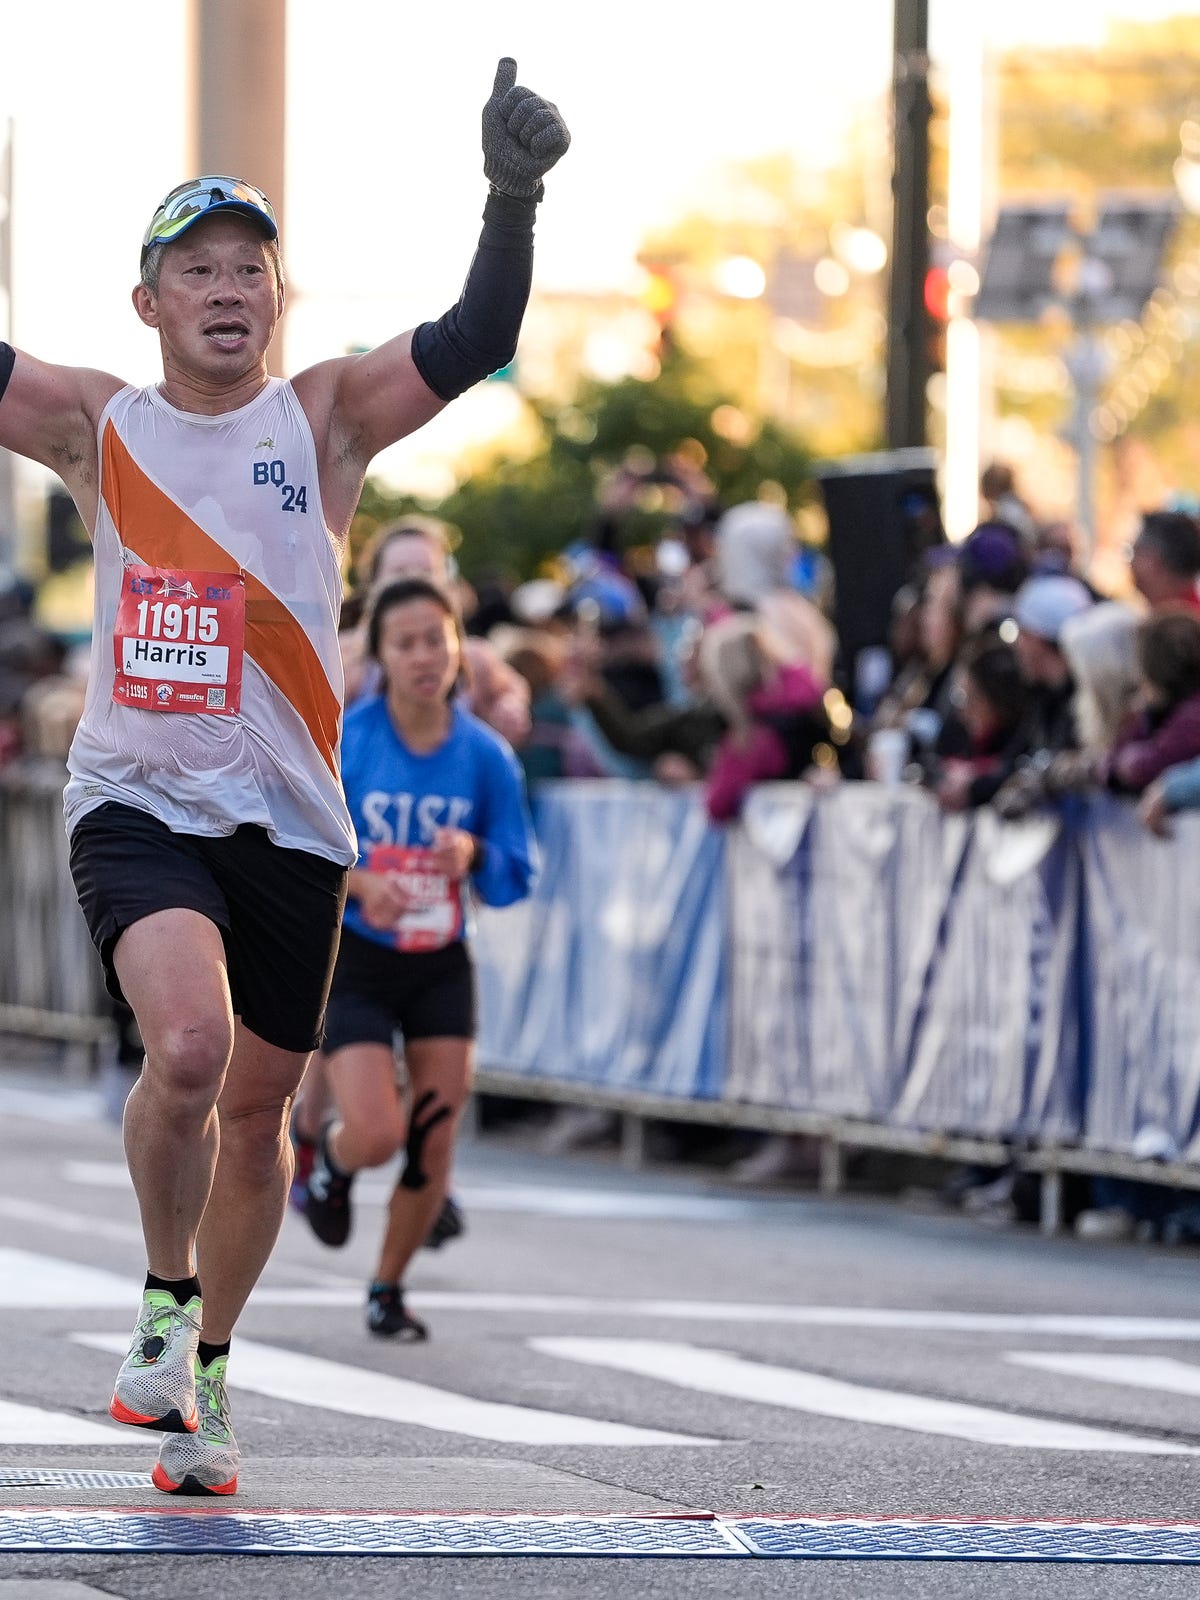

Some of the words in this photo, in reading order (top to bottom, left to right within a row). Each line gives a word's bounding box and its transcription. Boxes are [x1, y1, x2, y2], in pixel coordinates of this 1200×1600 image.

[253, 460, 286, 488] BQ
[281, 485, 307, 514] 24
[137, 600, 219, 643] 11915
[125, 660, 133, 670] A
[135, 640, 207, 667] Harris
[130, 683, 148, 700] 11915
